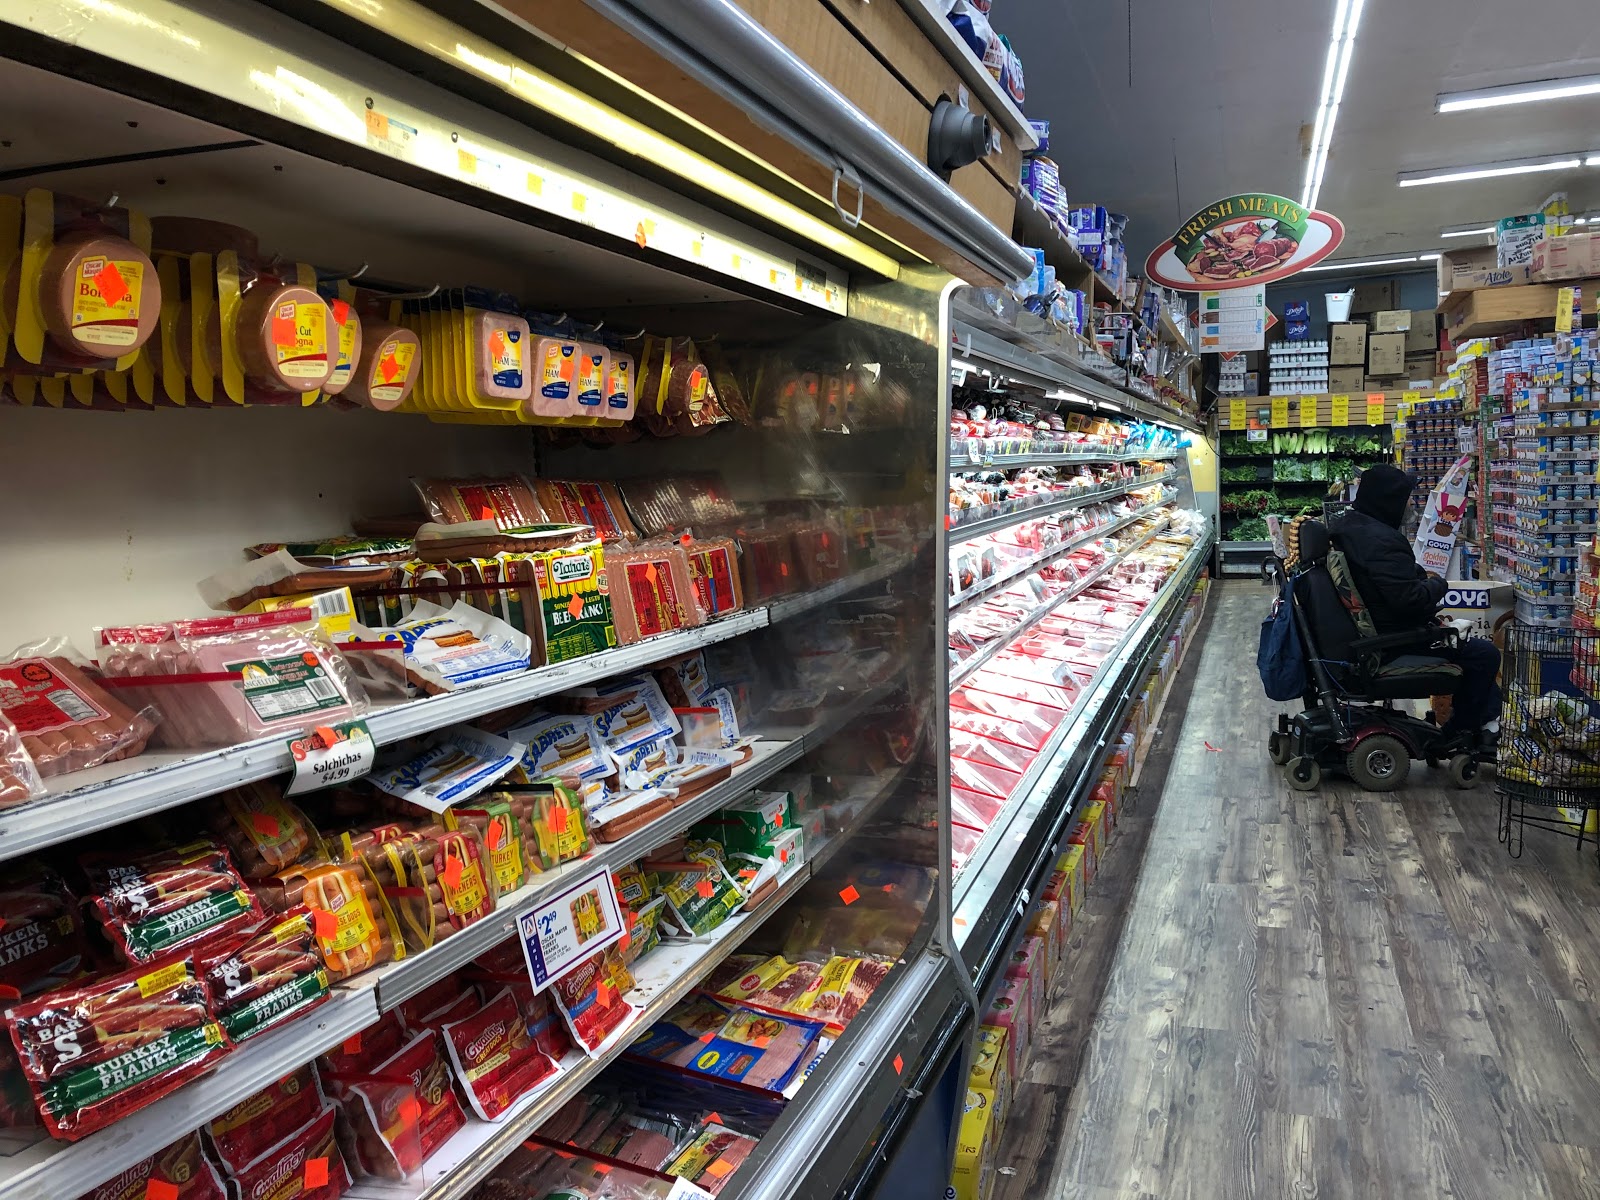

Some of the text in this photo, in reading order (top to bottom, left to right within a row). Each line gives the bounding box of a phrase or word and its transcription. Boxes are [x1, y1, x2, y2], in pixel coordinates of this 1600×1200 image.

[1178, 197, 1302, 245] FRESH MEATS
[1484, 270, 1513, 285] Atole
[295, 338, 314, 347] ogna
[300, 326, 312, 337] Cut
[1428, 540, 1450, 551] GOYA
[579, 603, 604, 620] RANKS
[290, 730, 348, 761] SPEL
[521, 722, 577, 775] SABRETT
[313, 752, 362, 775] Salchichas
[321, 767, 350, 784] $4.99
[491, 849, 514, 864] TURKEY
[112, 878, 146, 896] BAR
[160, 897, 214, 925] TURKEY
[169, 906, 221, 936] FRANKS
[348, 908, 361, 921] DOGS
[541, 934, 554, 945] OSCAR
[212, 958, 242, 977] BAR
[567, 962, 596, 998] Gwaltney
[255, 989, 304, 1023] FRANKS
[37, 1019, 83, 1041] BAR
[465, 1020, 506, 1060] Gwaltney
[54, 1032, 83, 1063] S
[93, 1037, 172, 1076] TURKEY
[100, 1045, 178, 1090] FRANKS
[252, 1148, 306, 1199] Gwaltney
